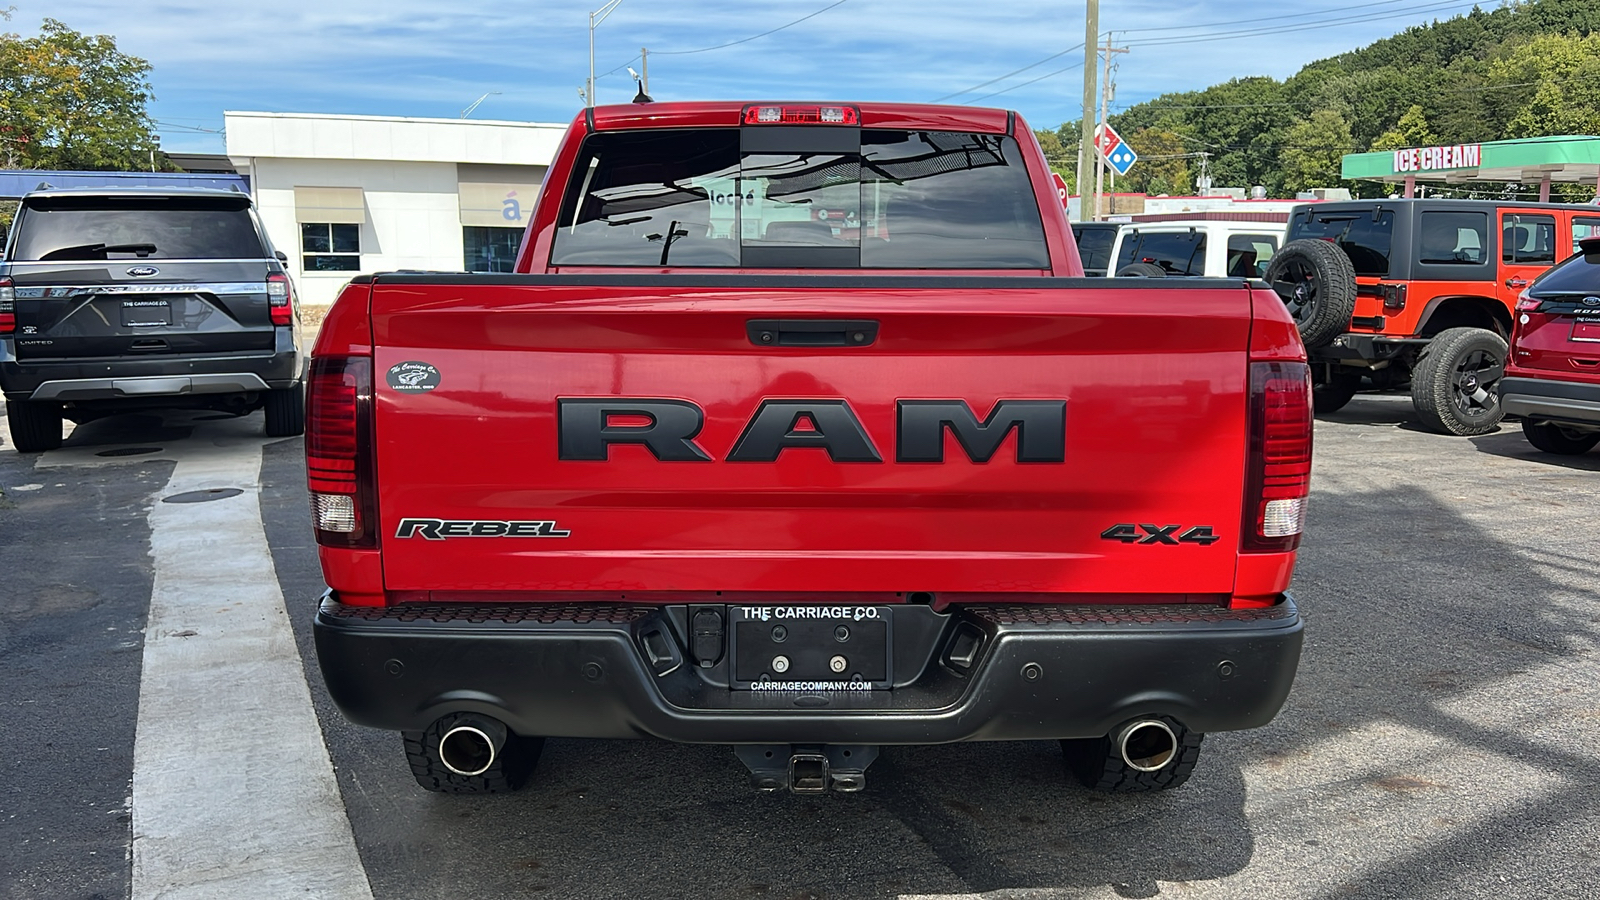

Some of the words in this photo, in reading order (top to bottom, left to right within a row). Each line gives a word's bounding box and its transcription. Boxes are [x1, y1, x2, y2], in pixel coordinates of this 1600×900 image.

[1394, 149, 1420, 172] ICE
[1421, 145, 1480, 170] CREAM
[502, 190, 522, 221] á
[557, 396, 1067, 463] RAM
[395, 518, 571, 541] REBEL
[742, 606, 771, 620] THE
[774, 606, 852, 620] CARRIAGE
[855, 606, 880, 620] CO.
[750, 681, 873, 691] CARRIAGECOMPANY.COM
